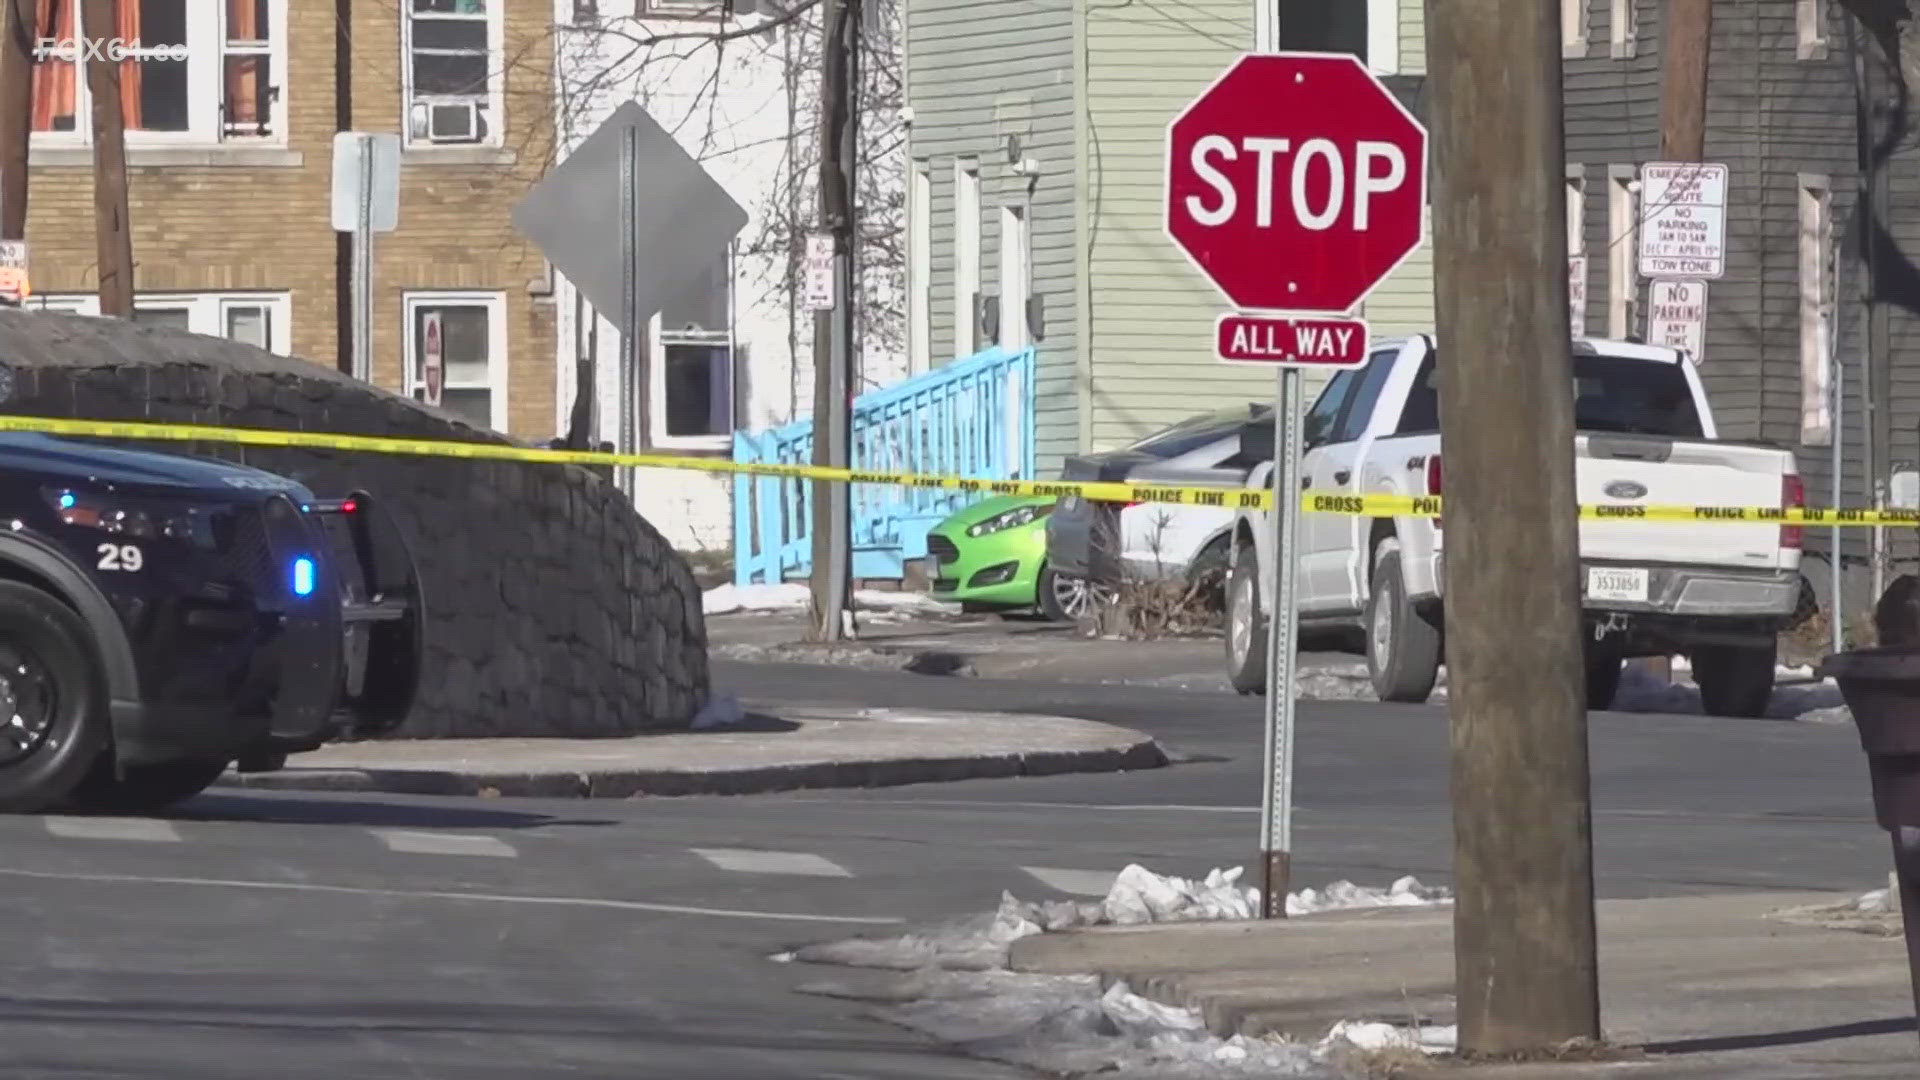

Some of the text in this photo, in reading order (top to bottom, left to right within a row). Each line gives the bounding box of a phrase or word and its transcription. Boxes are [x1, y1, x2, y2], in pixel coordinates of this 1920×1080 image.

[1648, 168, 1721, 180] EMERGENCY
[1185, 134, 1407, 231] STOP
[1664, 192, 1703, 202] ROUTE
[1674, 207, 1692, 219] NO
[1657, 219, 1708, 231] PARKING
[1651, 259, 1713, 272] TOW ZONE
[1667, 286, 1690, 303] NO
[1654, 304, 1702, 321] PARKING
[1667, 323, 1687, 334] ANY
[1230, 324, 1354, 358] ALL WAY
[991, 482, 1021, 495] NOT
[1032, 485, 1083, 497] CROSS
[1132, 487, 1442, 514] POLICE LINE DO CROSS POL
[1595, 504, 1646, 518] CROSS
[1695, 506, 1745, 519] POLICE
[1757, 507, 1788, 519] LINE
[1802, 509, 1824, 521] DO
[1835, 510, 1865, 522] NOT
[1878, 511, 1920, 522] CROS
[96, 542, 144, 573] 29
